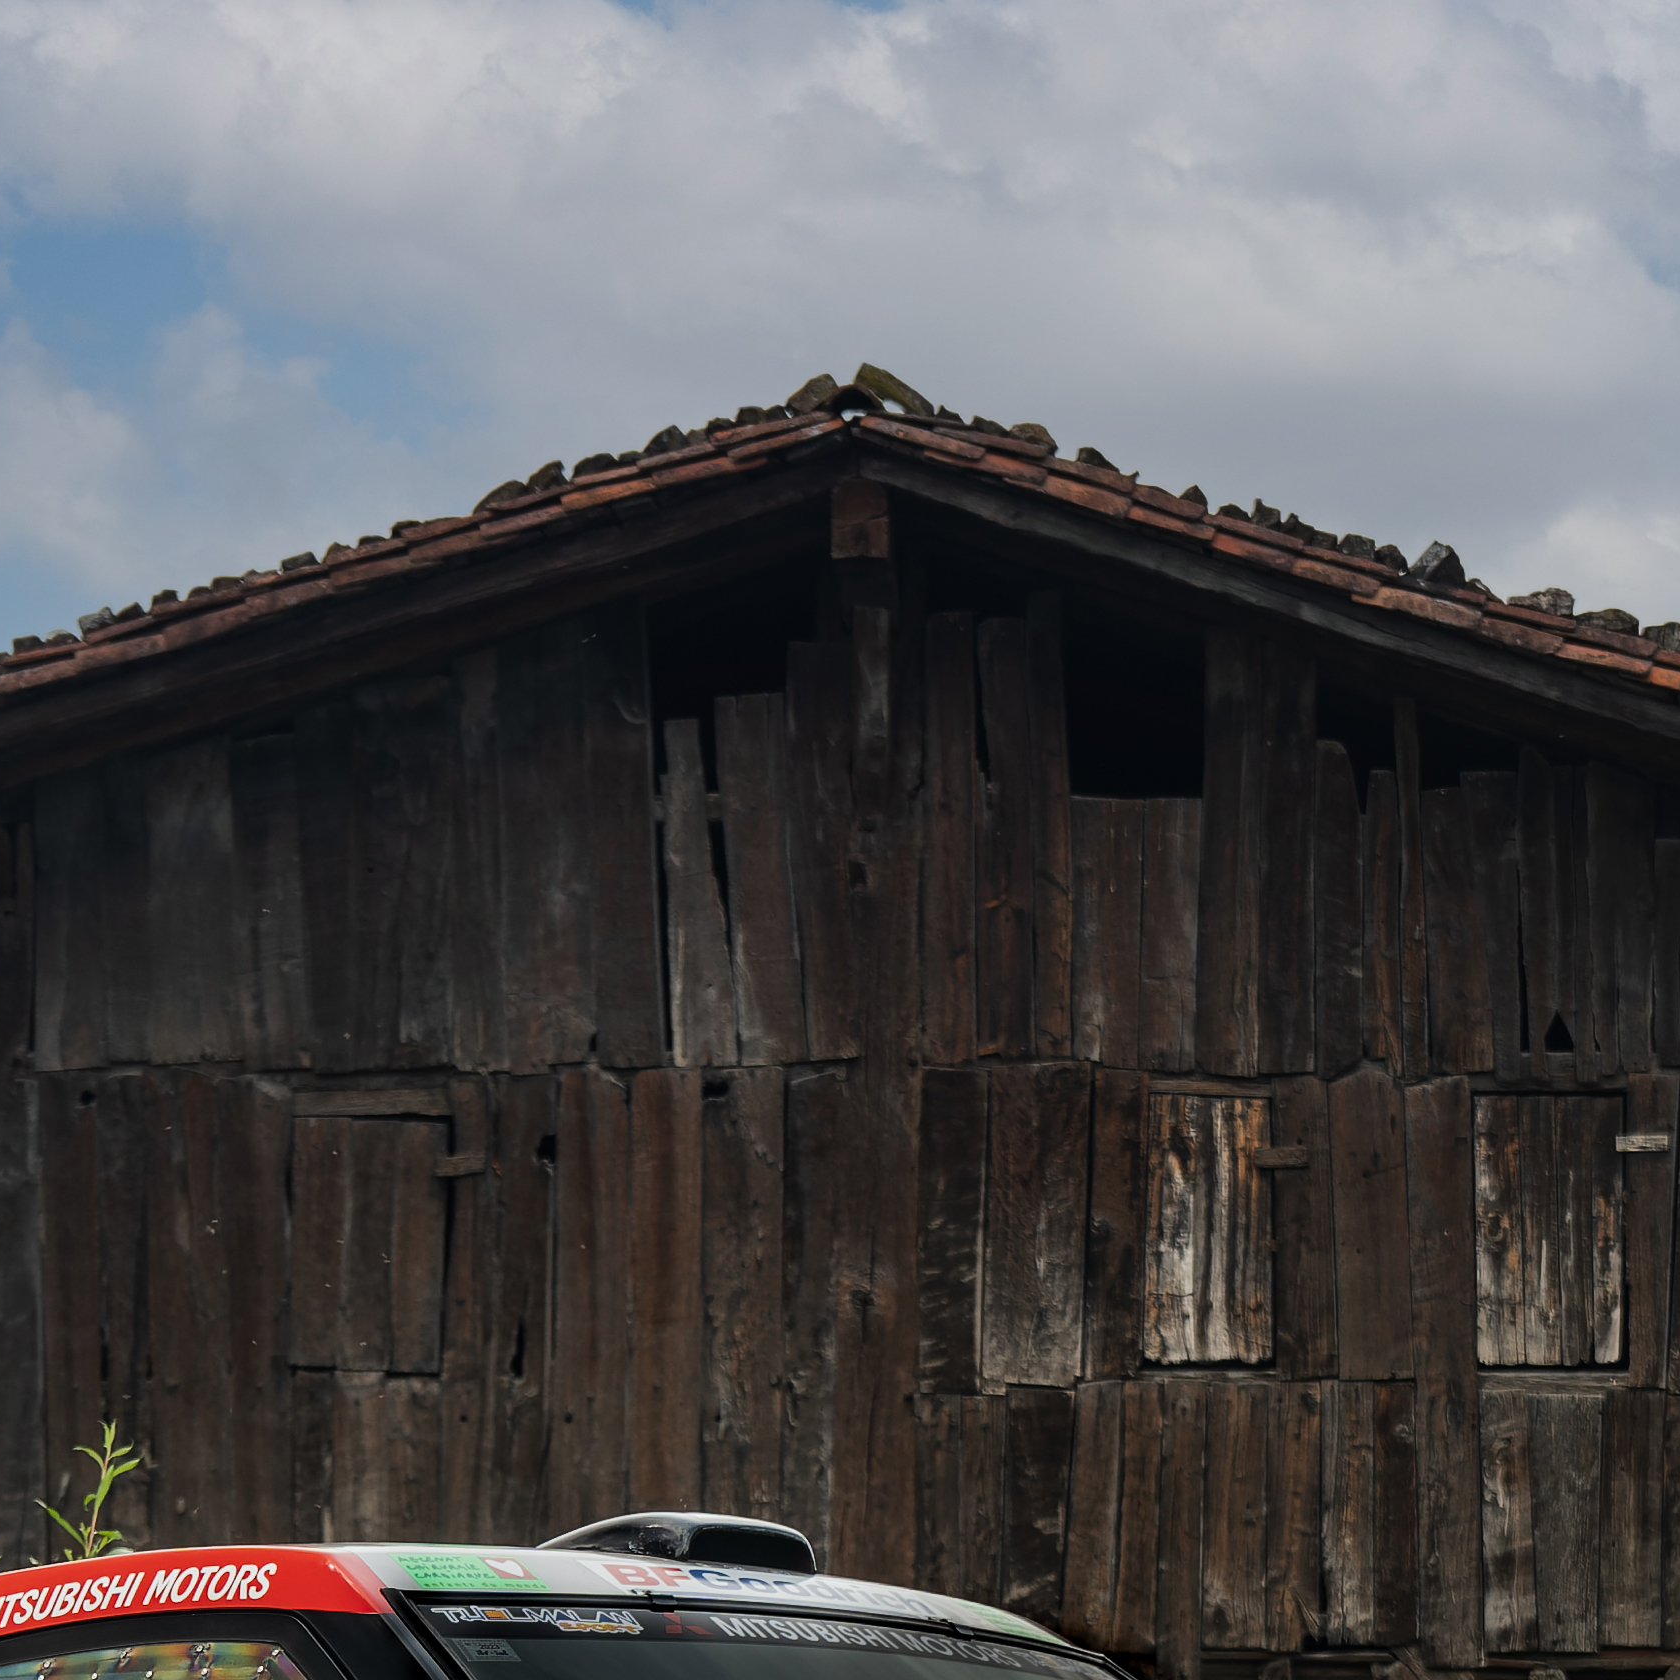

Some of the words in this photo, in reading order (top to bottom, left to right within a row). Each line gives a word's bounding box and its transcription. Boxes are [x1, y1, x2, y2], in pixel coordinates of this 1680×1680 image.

[142, 1562, 278, 1603] MOTORS
[603, 1563, 936, 1616] BFGoodrich
[709, 1616, 899, 1650] MITSUBISHI
[898, 1630, 1021, 1668] MOTORS
